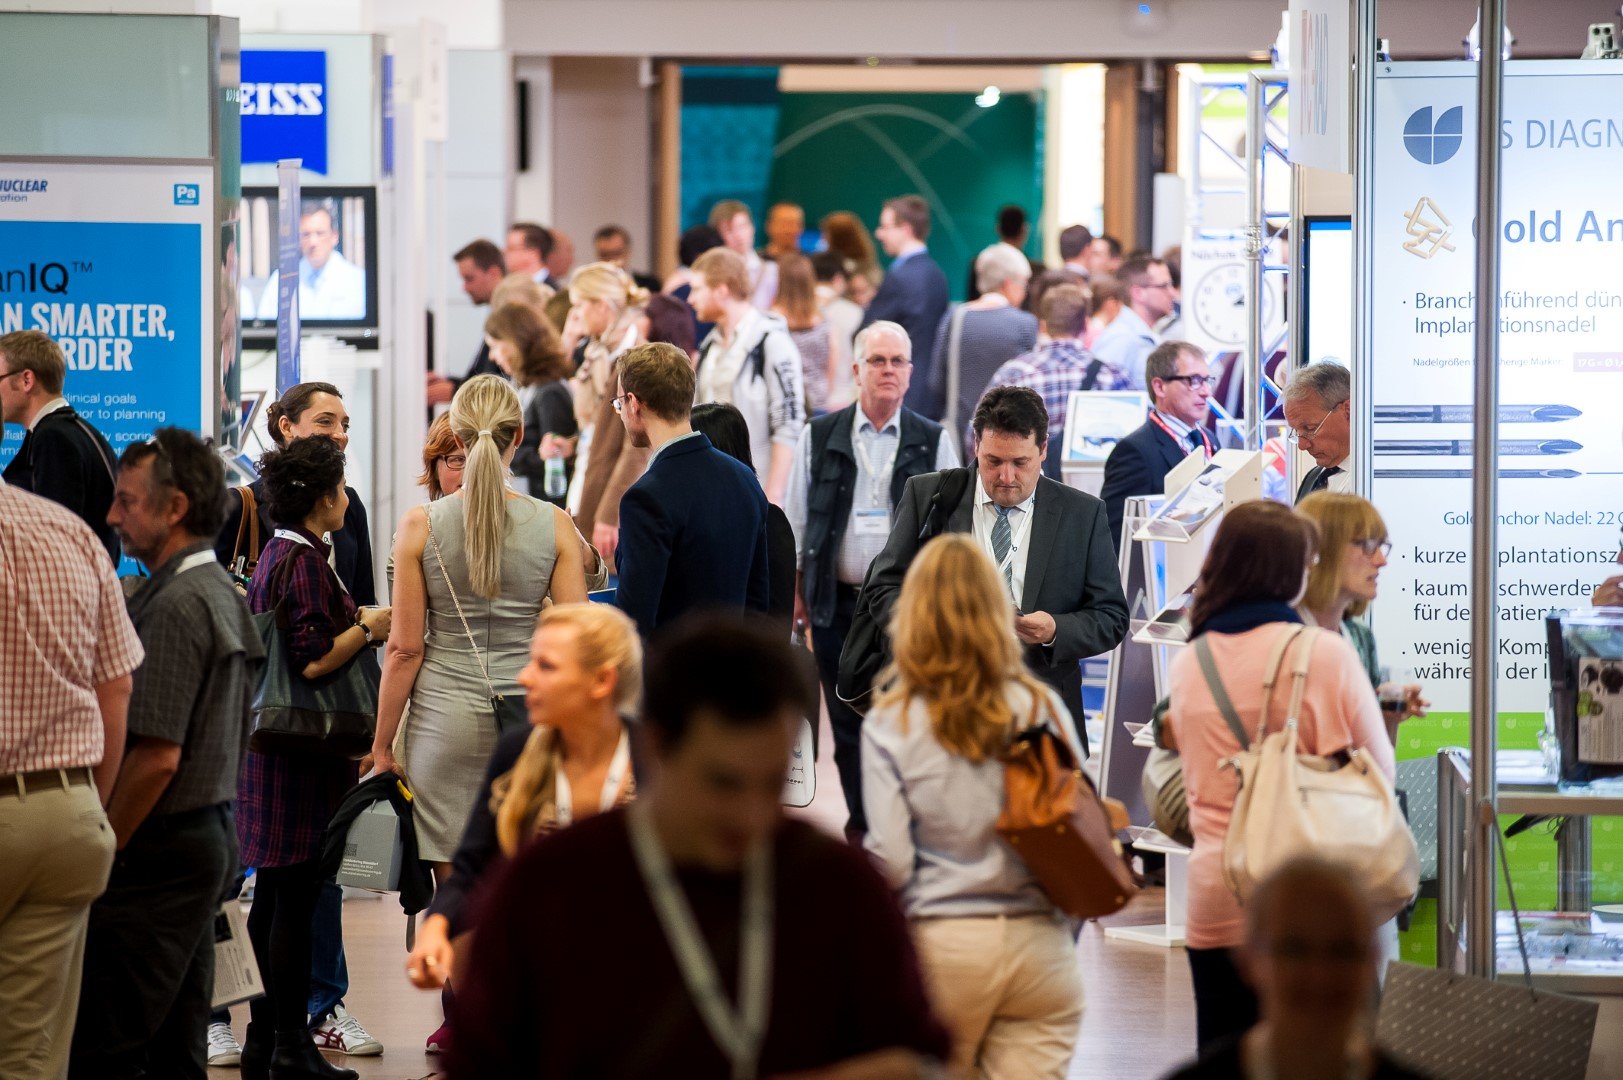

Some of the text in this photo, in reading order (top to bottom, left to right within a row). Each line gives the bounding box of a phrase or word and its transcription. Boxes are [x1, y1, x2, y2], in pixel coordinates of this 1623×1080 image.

[1526, 119, 1623, 149] DIAGN
[0, 180, 48, 192] UCLEAR
[177, 186, 196, 199] Pa
[31, 303, 175, 342] SMARTER,
[58, 338, 133, 371] RDER
[1413, 358, 1470, 368] Nadelgrößen
[104, 394, 137, 407] goals
[98, 410, 111, 419] to
[114, 409, 166, 422] planning
[115, 432, 155, 442] scorin
[1498, 511, 1539, 525] nchor
[1545, 511, 1592, 525] Nadel:
[1597, 512, 1614, 524] 22
[1415, 546, 1617, 567] kurze plantationsz
[1415, 579, 1467, 596] kaum
[1414, 603, 1441, 620] für
[1446, 603, 1470, 620] de
[1414, 639, 1549, 659] wenig Komp
[1506, 663, 1538, 679] der
